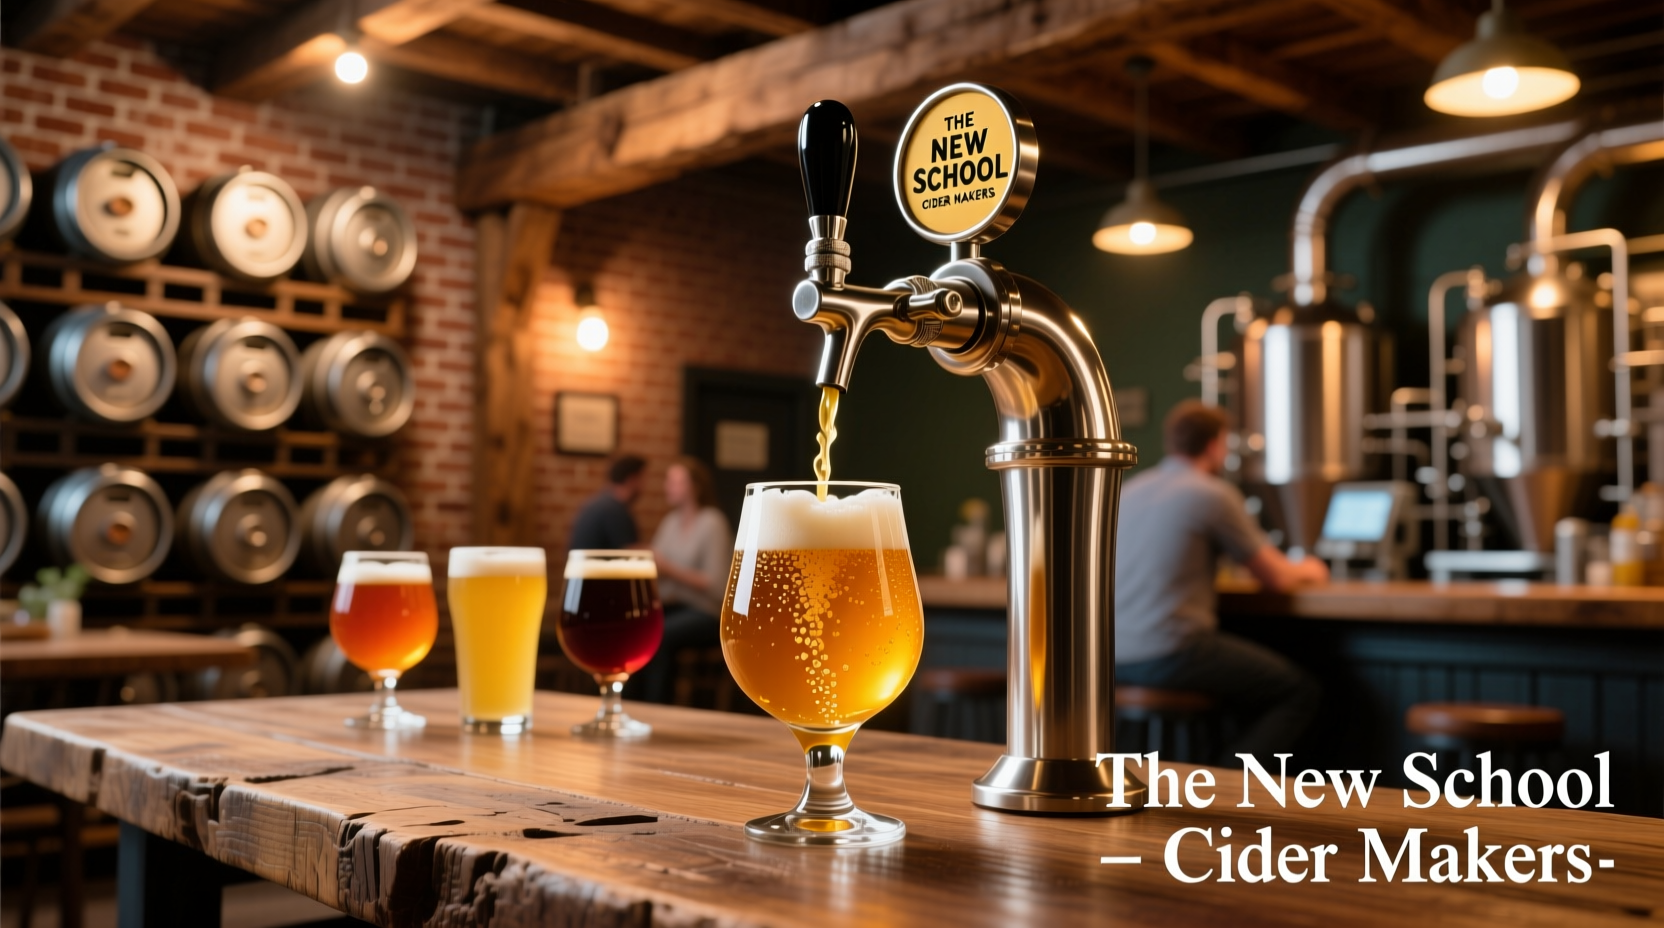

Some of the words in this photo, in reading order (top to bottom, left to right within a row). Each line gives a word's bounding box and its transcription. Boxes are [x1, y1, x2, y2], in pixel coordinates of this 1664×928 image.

[944, 111, 975, 131] THE
[931, 128, 988, 163] NEW
[913, 153, 1009, 194] SCHOOL
[922, 195, 951, 210] CIDER
